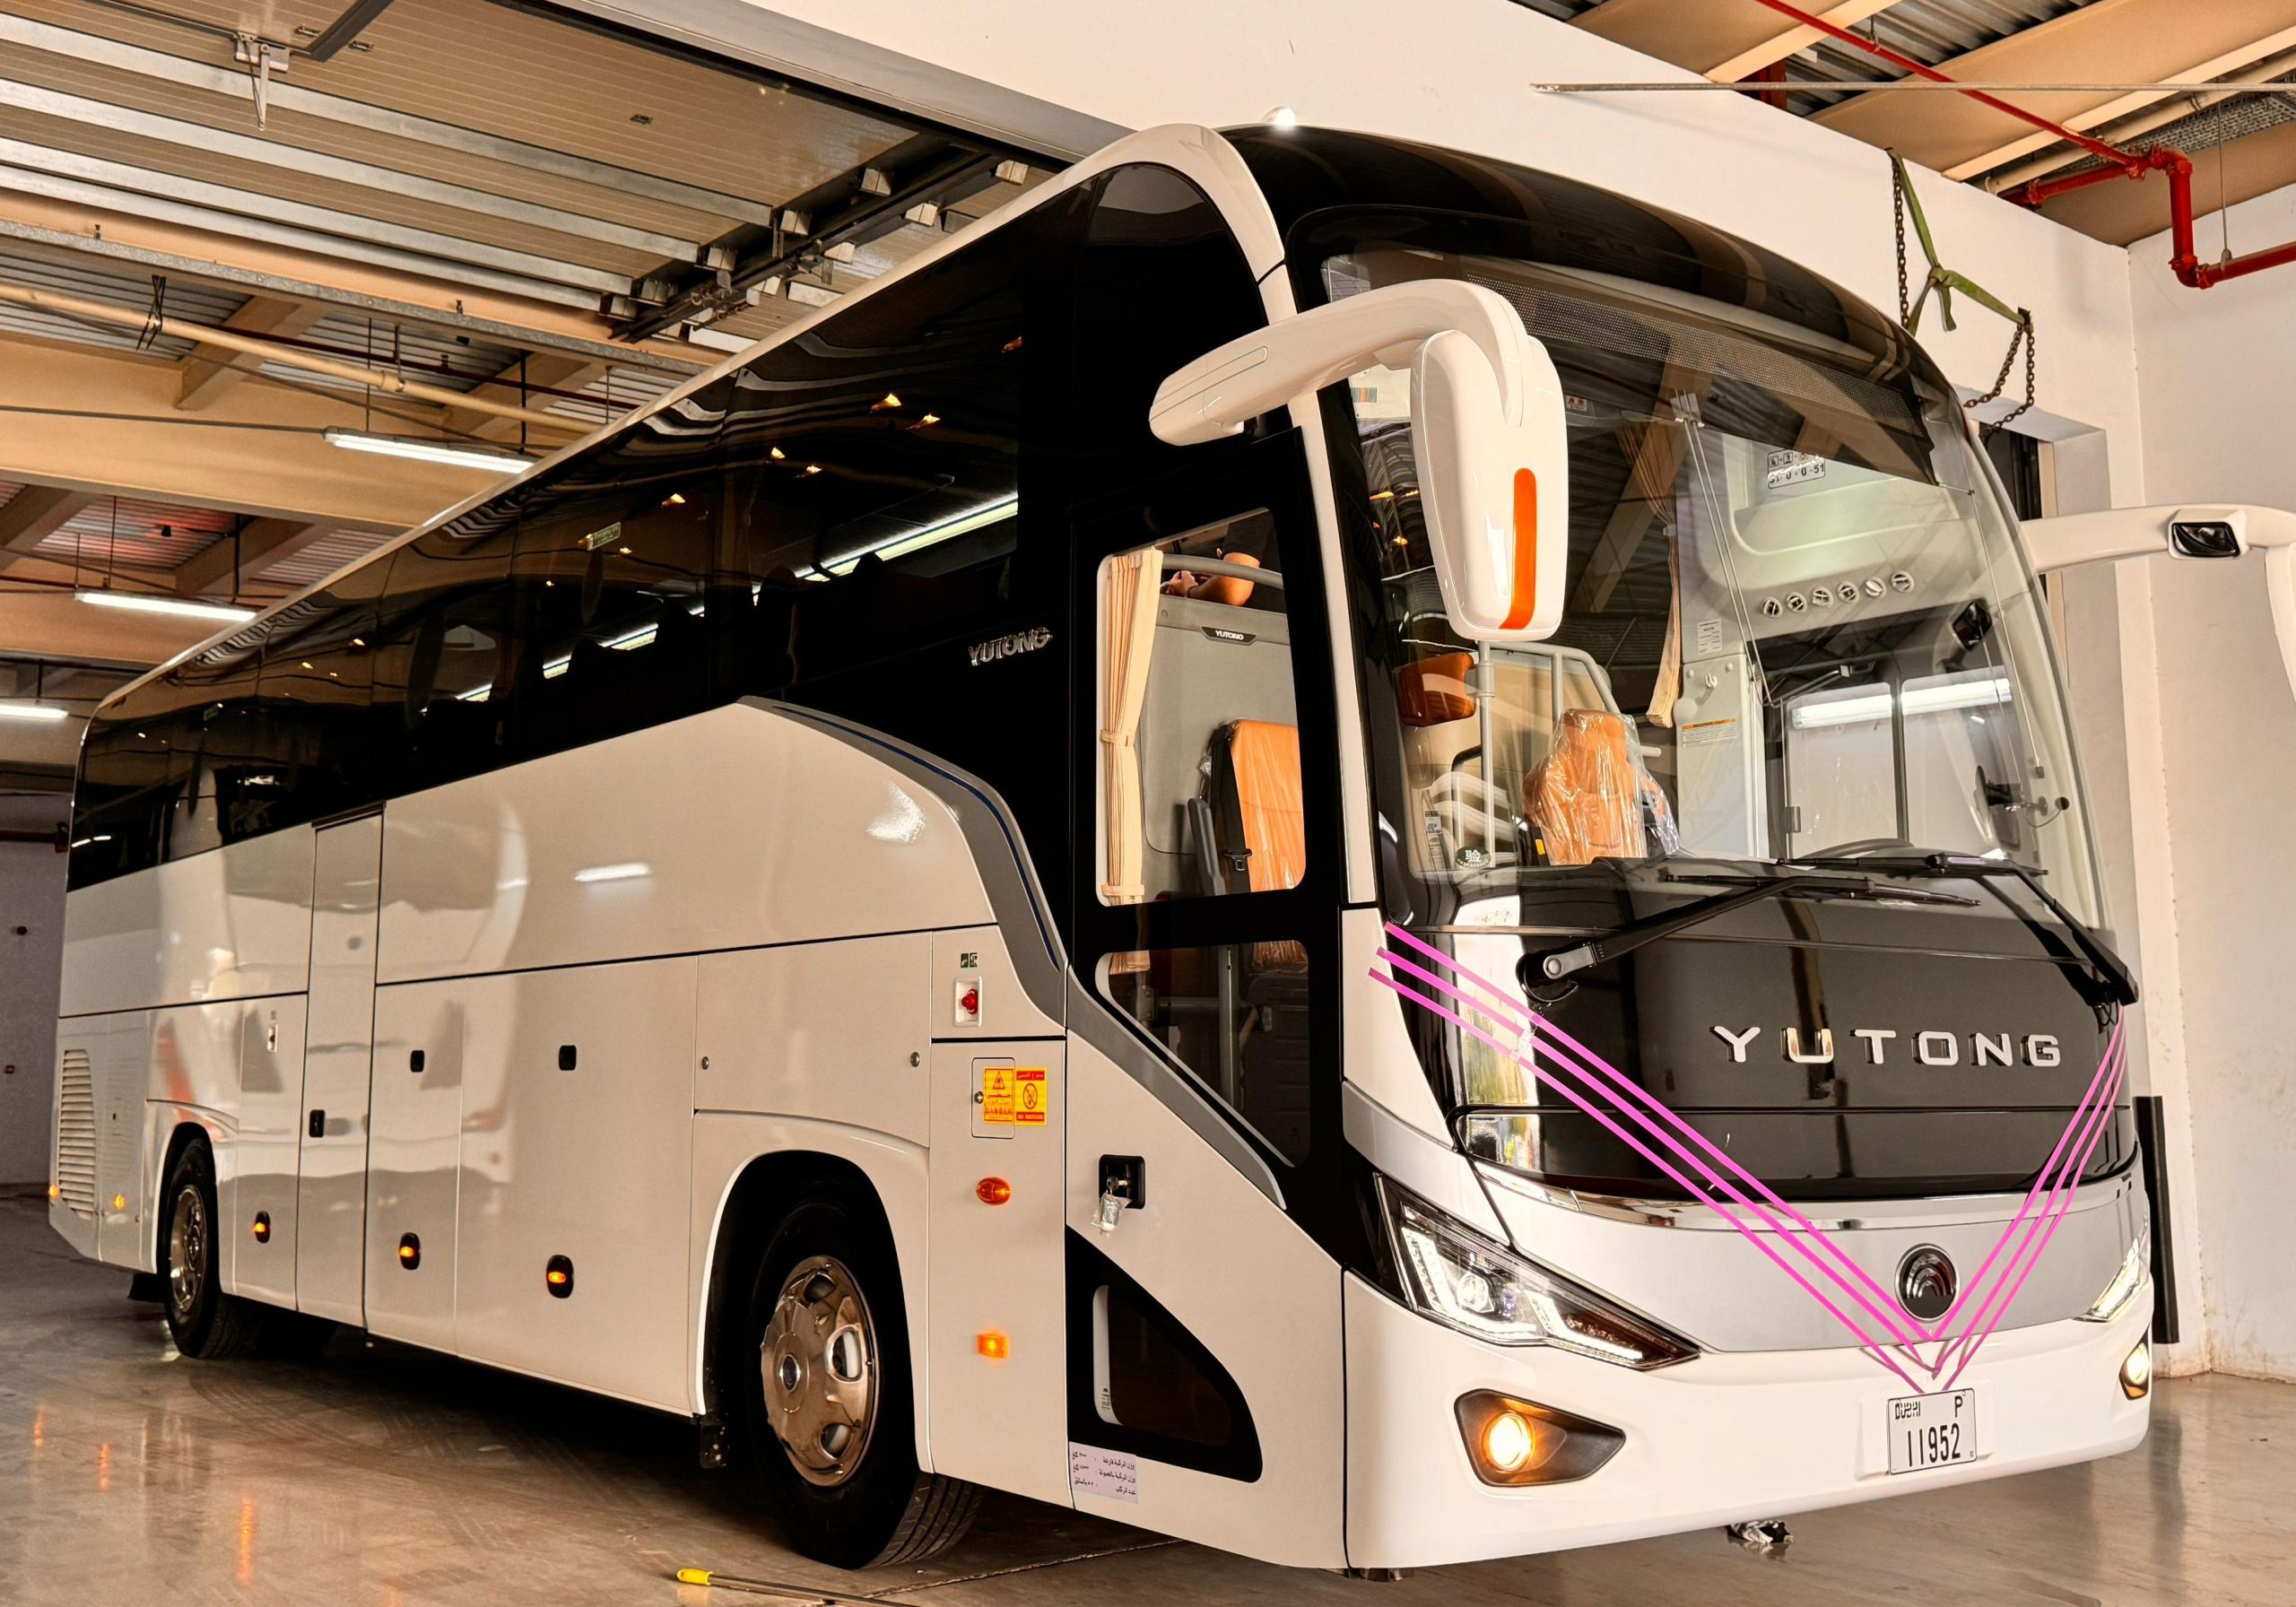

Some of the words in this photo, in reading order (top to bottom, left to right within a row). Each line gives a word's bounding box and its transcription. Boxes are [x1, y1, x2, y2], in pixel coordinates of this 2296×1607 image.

[967, 626, 1054, 666] YUTONG
[1709, 1025, 2061, 1067] YUTONG
[1954, 1395, 1963, 1418] P
[1908, 1422, 1961, 1467] 11952
